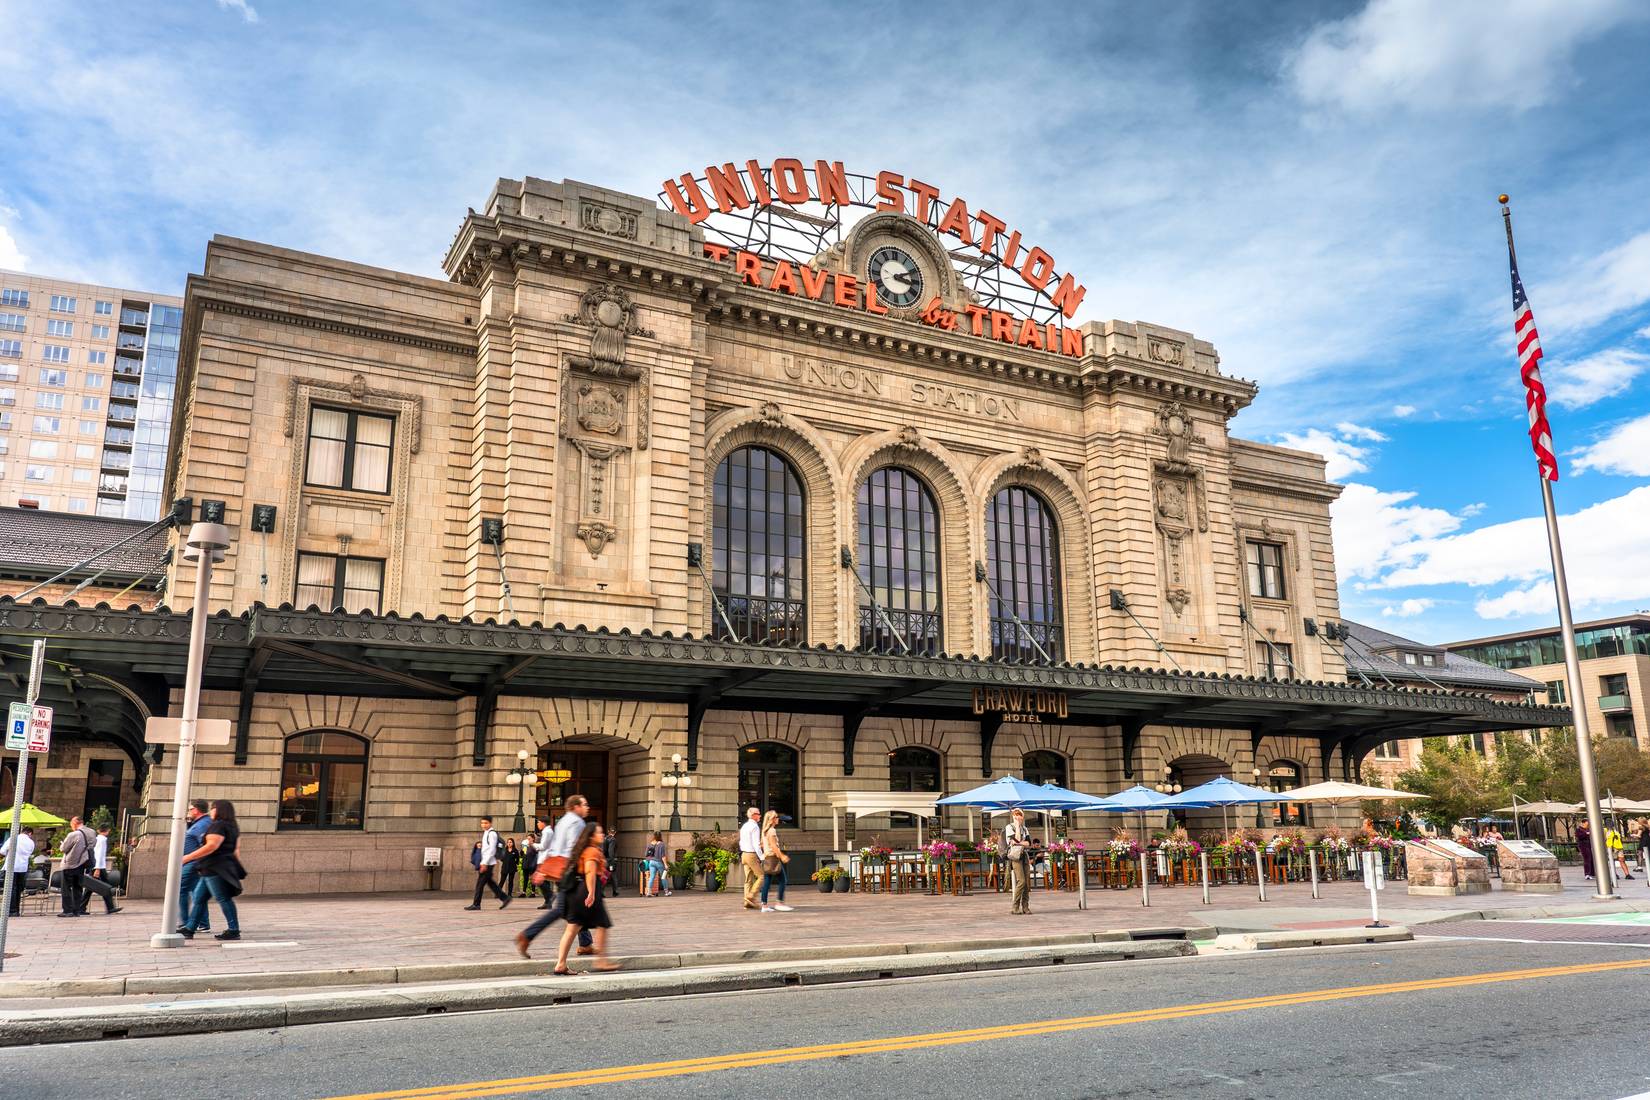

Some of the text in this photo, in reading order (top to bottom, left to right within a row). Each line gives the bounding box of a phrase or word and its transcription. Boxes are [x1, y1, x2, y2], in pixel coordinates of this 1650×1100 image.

[662, 158, 850, 224] UNION
[875, 170, 1087, 319] STATION
[703, 241, 889, 315] TRAVEL
[920, 296, 959, 331] by
[965, 303, 1084, 358] TRAIN
[782, 357, 1022, 421] UNION STATION
[37, 709, 46, 719] NO
[972, 687, 1068, 718] CRAWFORD
[31, 719, 50, 729] PARKING
[1003, 714, 1042, 723] HOTEL
